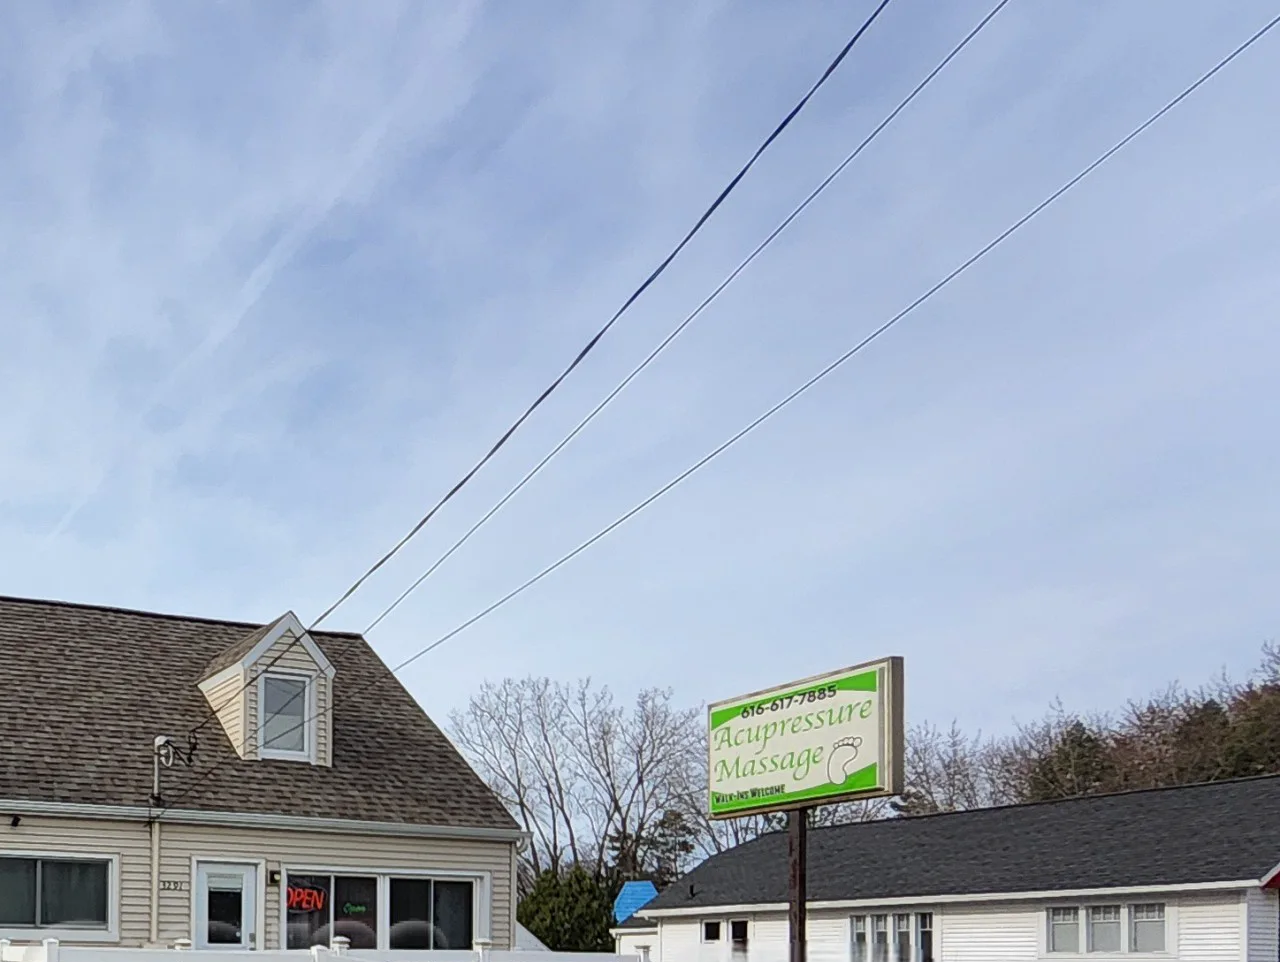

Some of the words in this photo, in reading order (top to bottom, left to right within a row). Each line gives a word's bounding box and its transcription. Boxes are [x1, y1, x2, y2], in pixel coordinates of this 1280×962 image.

[741, 685, 837, 719] 616-617-7885
[713, 699, 873, 755] Acupressure
[713, 745, 824, 782] Massage
